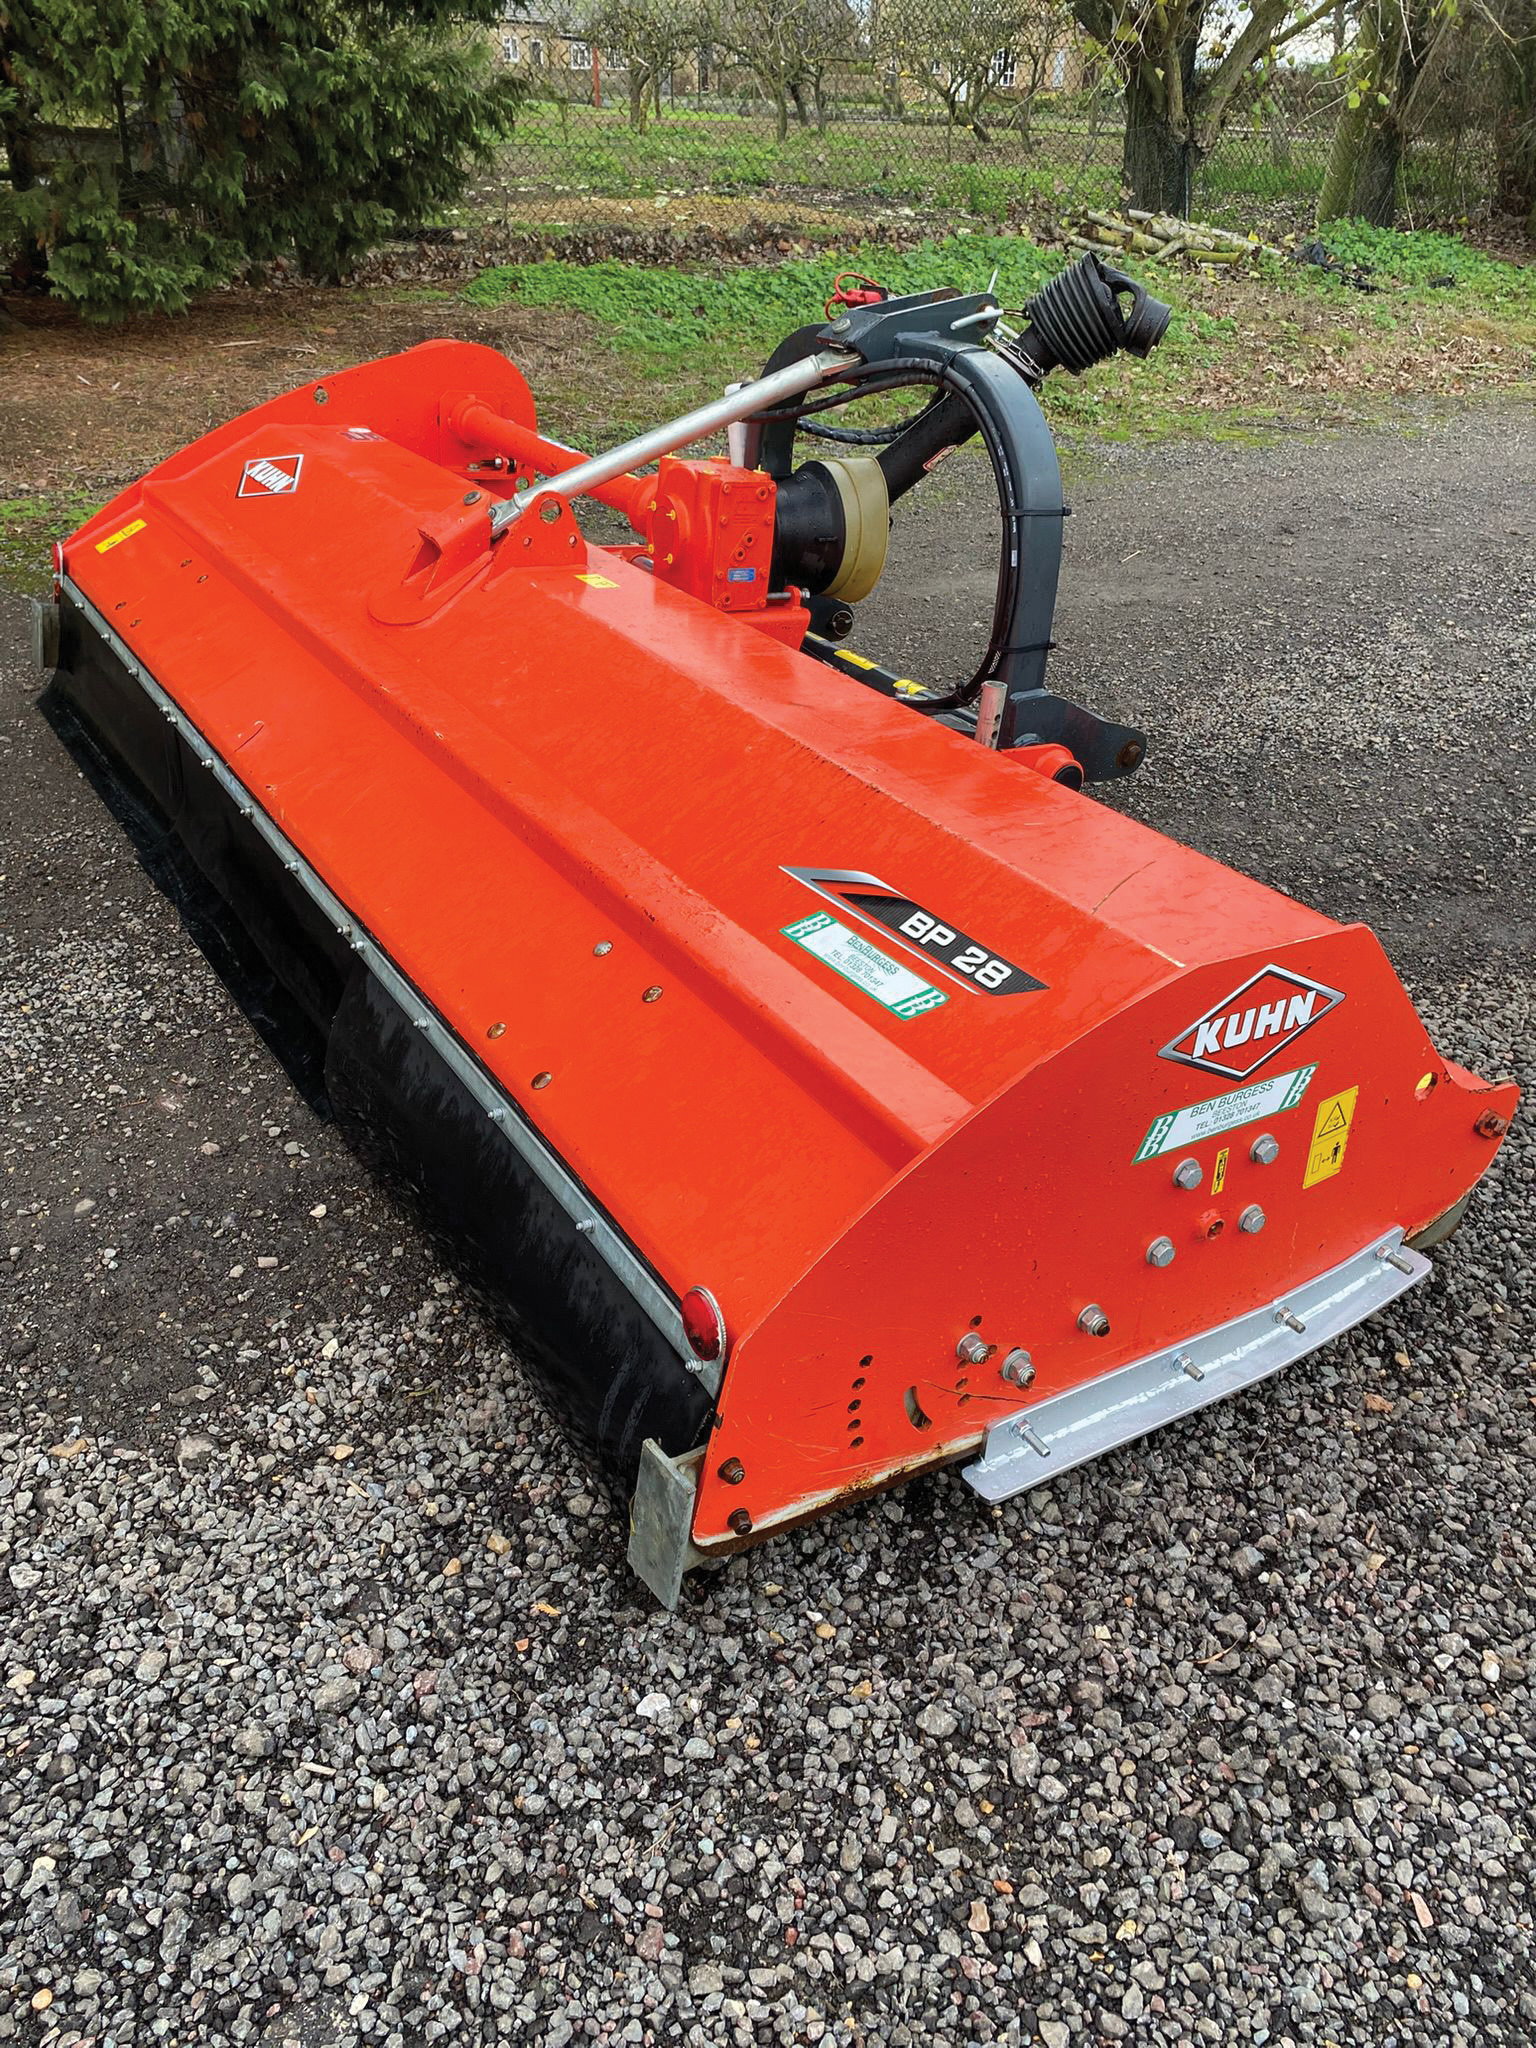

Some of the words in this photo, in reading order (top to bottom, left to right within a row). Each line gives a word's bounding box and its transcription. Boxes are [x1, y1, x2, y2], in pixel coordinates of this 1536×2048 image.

[246, 460, 295, 493] KUHN
[898, 910, 957, 948] BP
[950, 945, 1012, 990] 28
[1191, 989, 1317, 1059] KUHN
[1190, 1101, 1217, 1118] BEN
[1217, 1081, 1275, 1108] BURGESS
[1211, 1100, 1248, 1118] BEESTON
